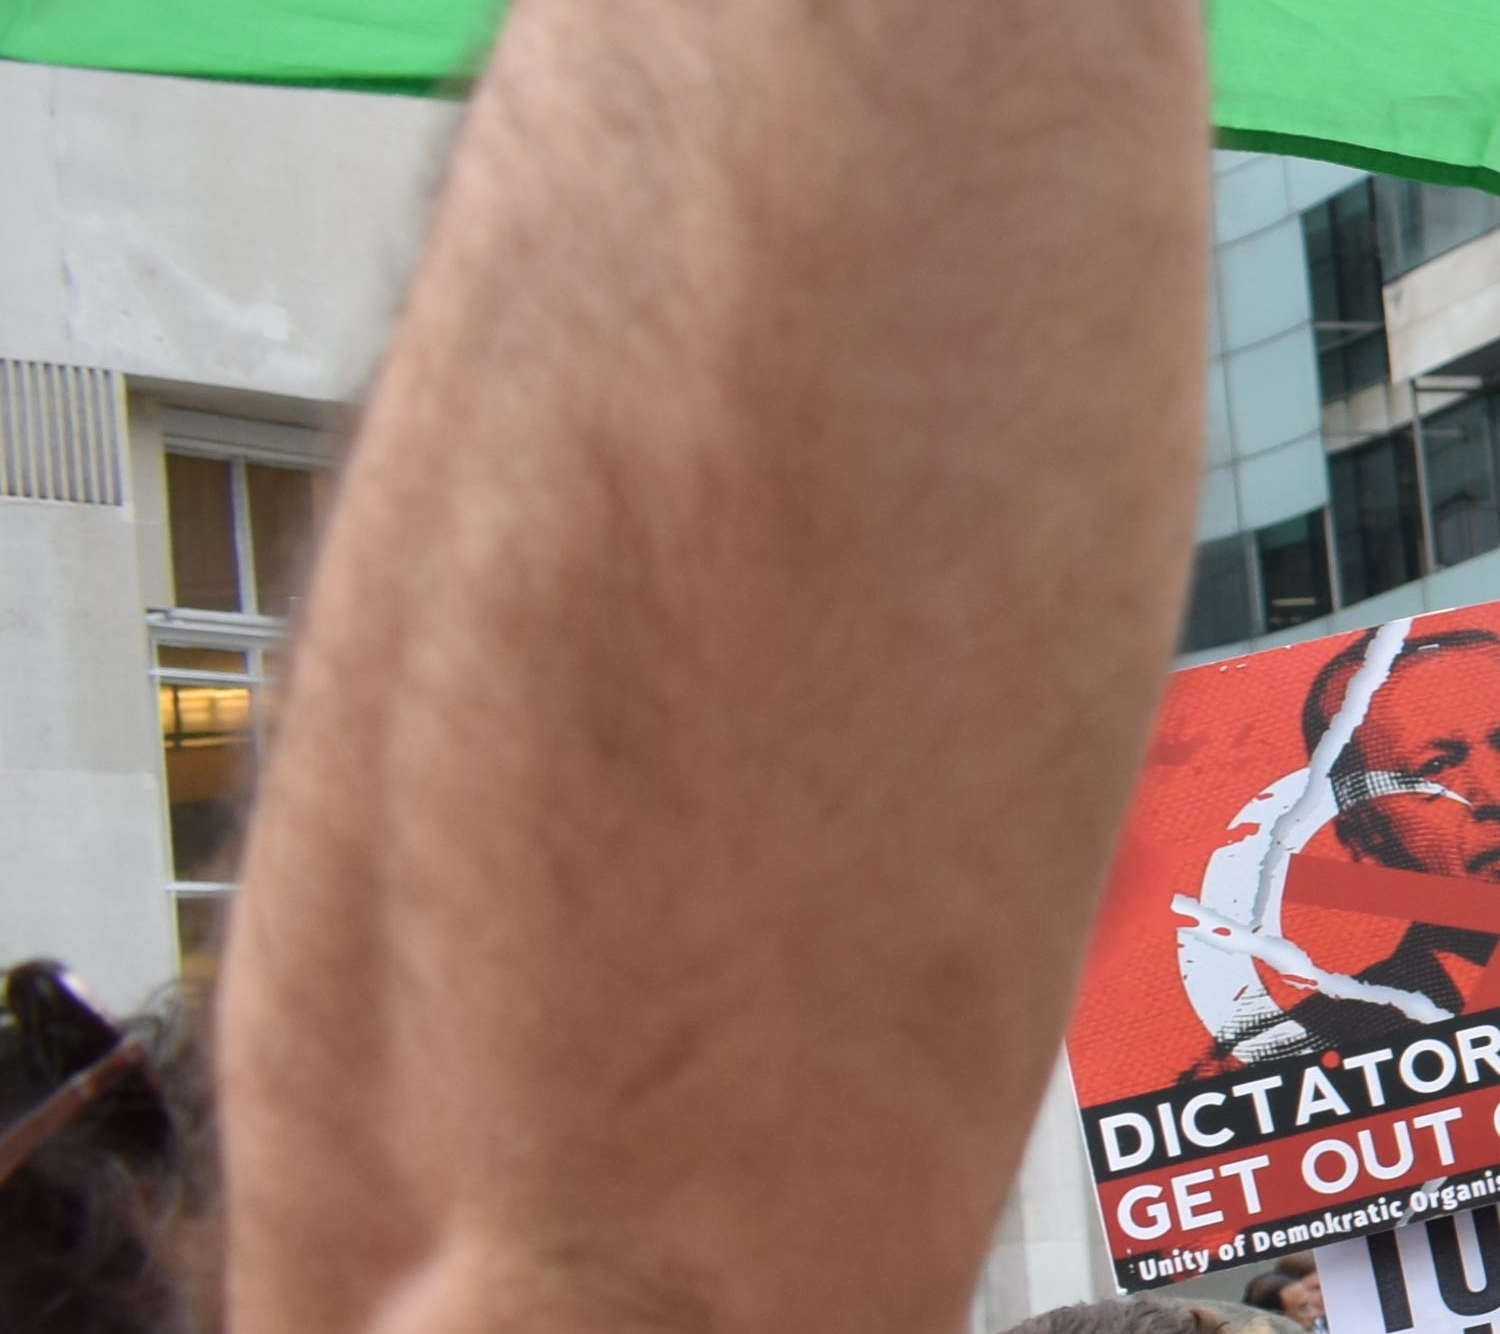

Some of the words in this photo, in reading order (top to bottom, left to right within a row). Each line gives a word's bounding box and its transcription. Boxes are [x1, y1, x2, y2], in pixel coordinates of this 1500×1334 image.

[1116, 1154, 1271, 1242] GET
[1300, 1107, 1463, 1195] OUT
[1138, 1244, 1210, 1283] Unity
[1219, 1234, 1247, 1262] of
[1252, 1199, 1404, 1254] Demokratic
